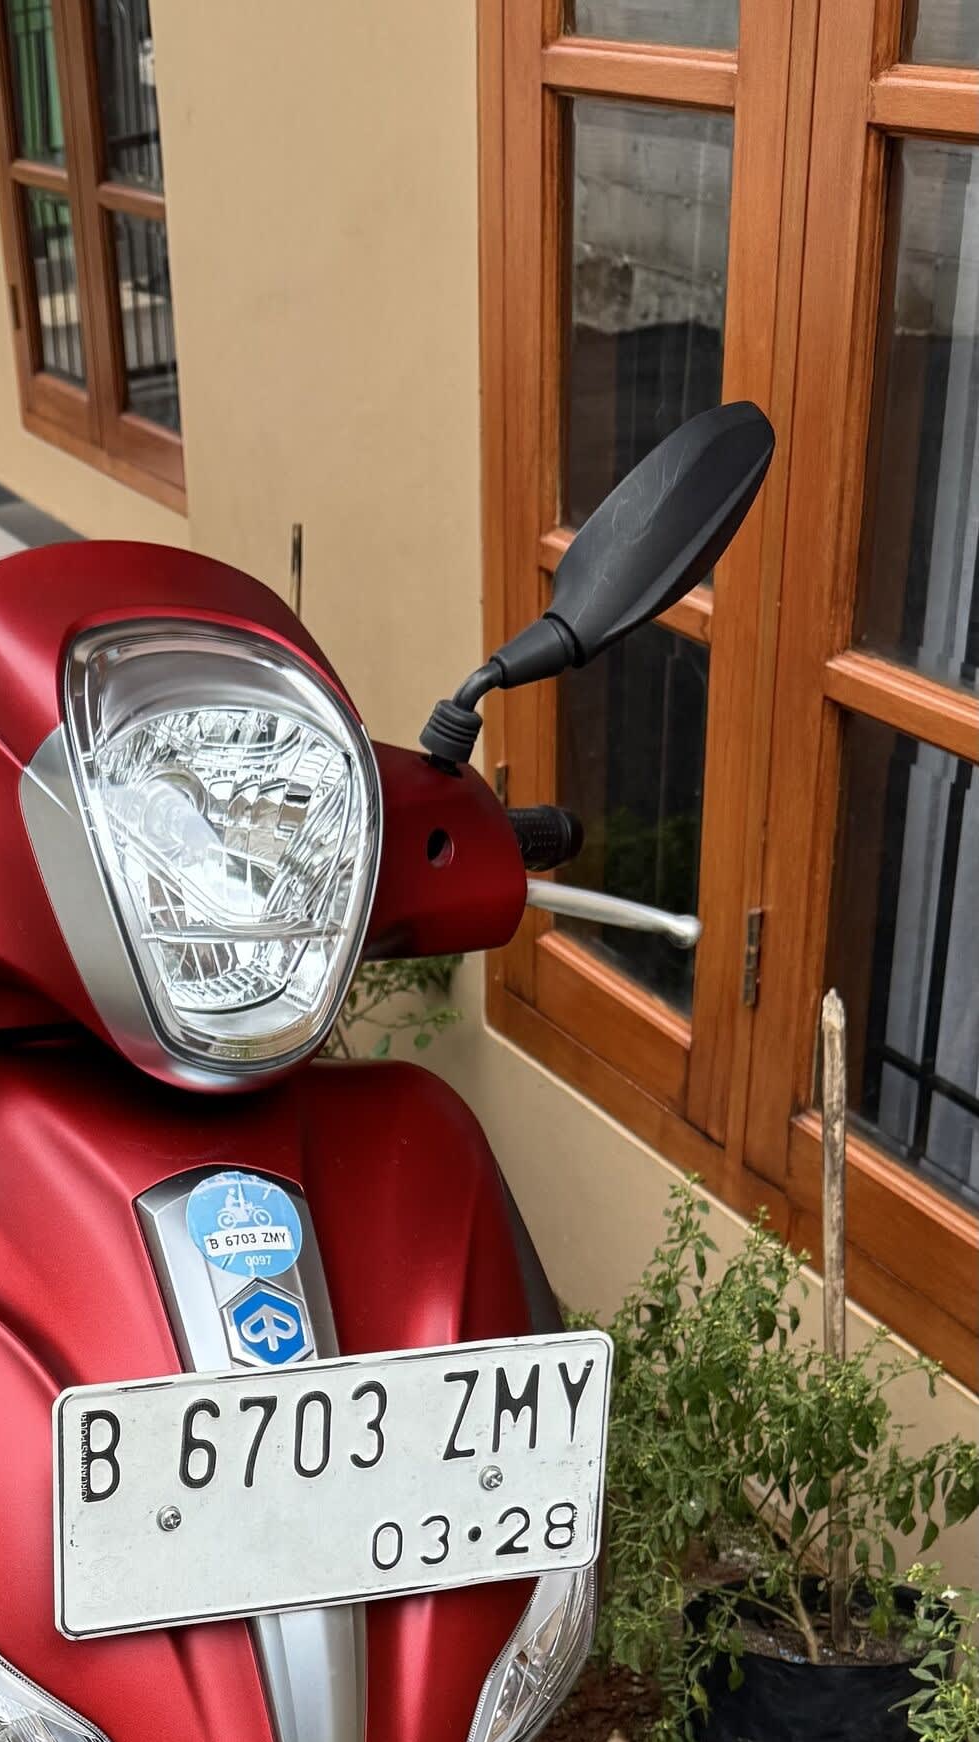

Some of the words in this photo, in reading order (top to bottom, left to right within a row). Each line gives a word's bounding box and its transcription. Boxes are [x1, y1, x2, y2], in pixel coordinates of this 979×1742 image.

[209, 1238, 219, 1250] B
[225, 1233, 257, 1246] 6703
[261, 1232, 286, 1243] ZMY
[245, 1255, 272, 1265] 0097
[81, 1410, 120, 1502] B
[178, 1380, 388, 1488] 6703
[442, 1359, 595, 1461] ZMY
